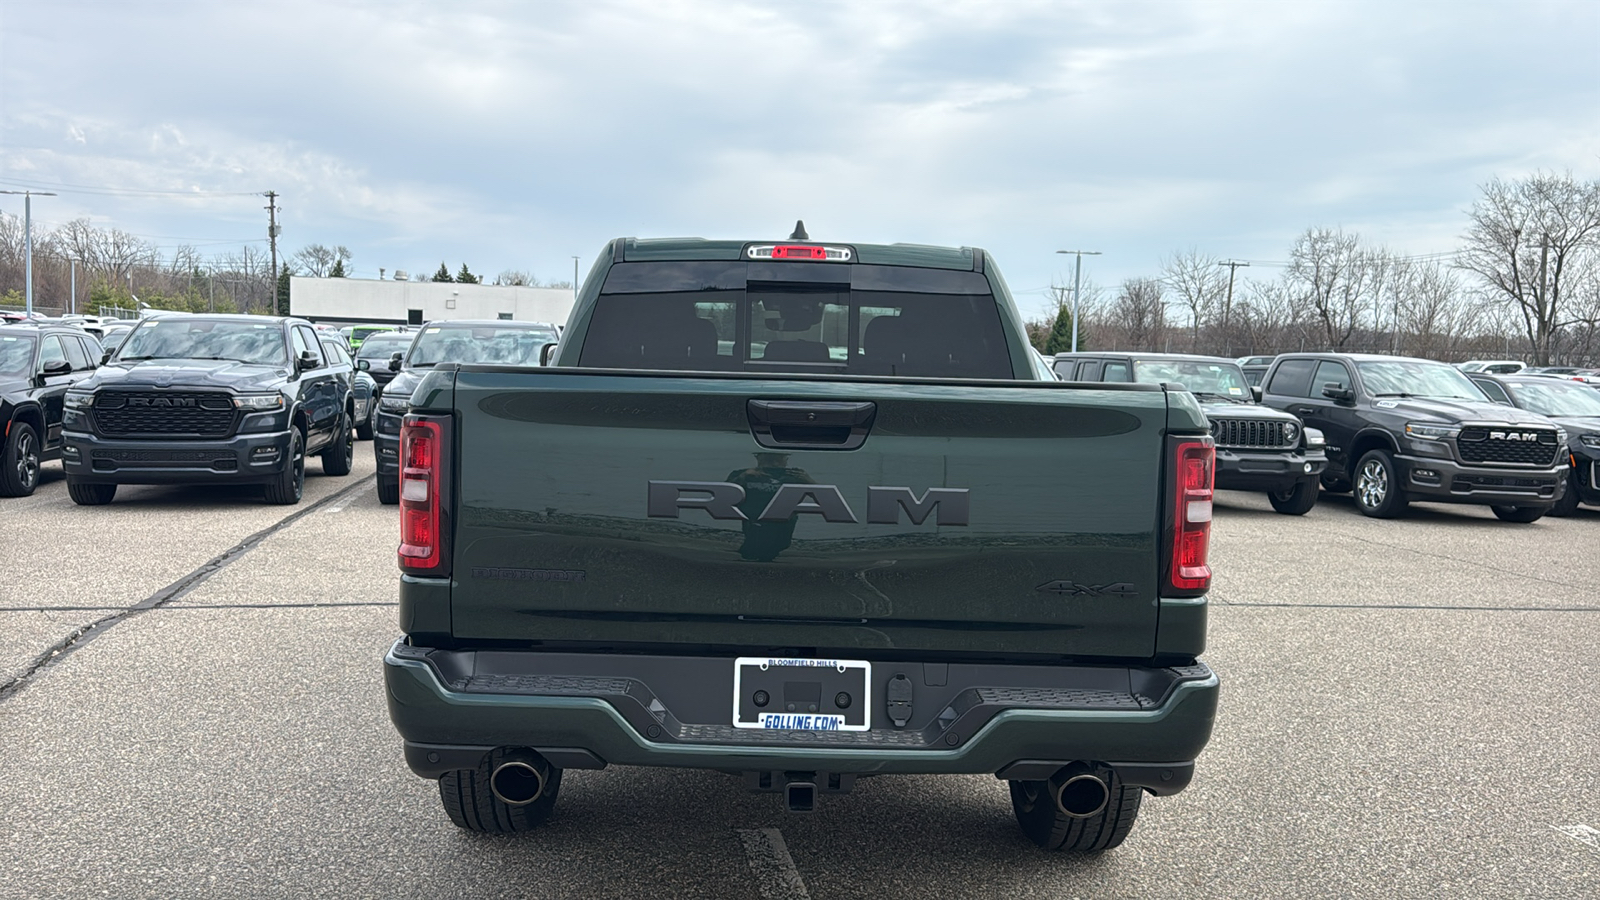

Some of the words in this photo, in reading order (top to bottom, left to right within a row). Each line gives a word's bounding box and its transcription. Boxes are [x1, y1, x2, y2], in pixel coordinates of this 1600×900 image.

[128, 397, 196, 407] RAM
[1490, 431, 1537, 442] RAM
[647, 480, 970, 526] RAM
[768, 659, 815, 667] BLOOMFIELD
[816, 660, 838, 668] HILLS
[764, 715, 839, 730] GOLLING.COM
